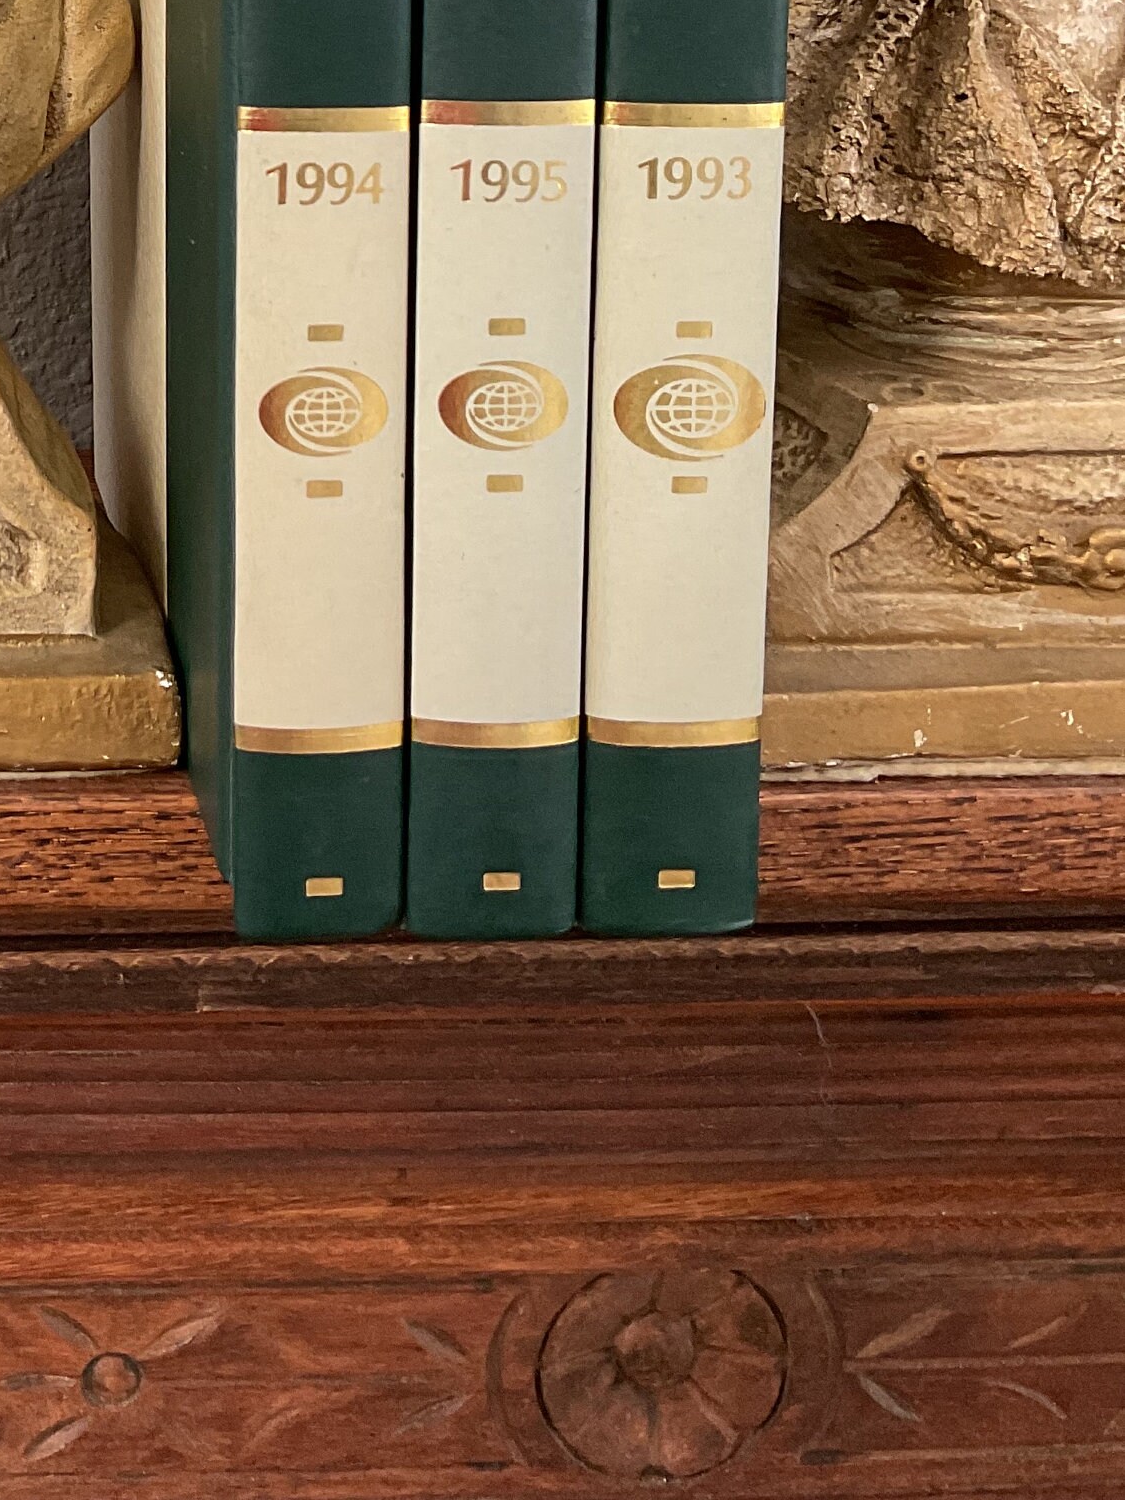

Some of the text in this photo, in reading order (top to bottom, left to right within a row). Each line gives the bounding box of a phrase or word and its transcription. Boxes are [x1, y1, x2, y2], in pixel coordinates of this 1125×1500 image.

[265, 161, 385, 206] 1994
[449, 158, 569, 203] 1995
[637, 155, 754, 201] 1993
